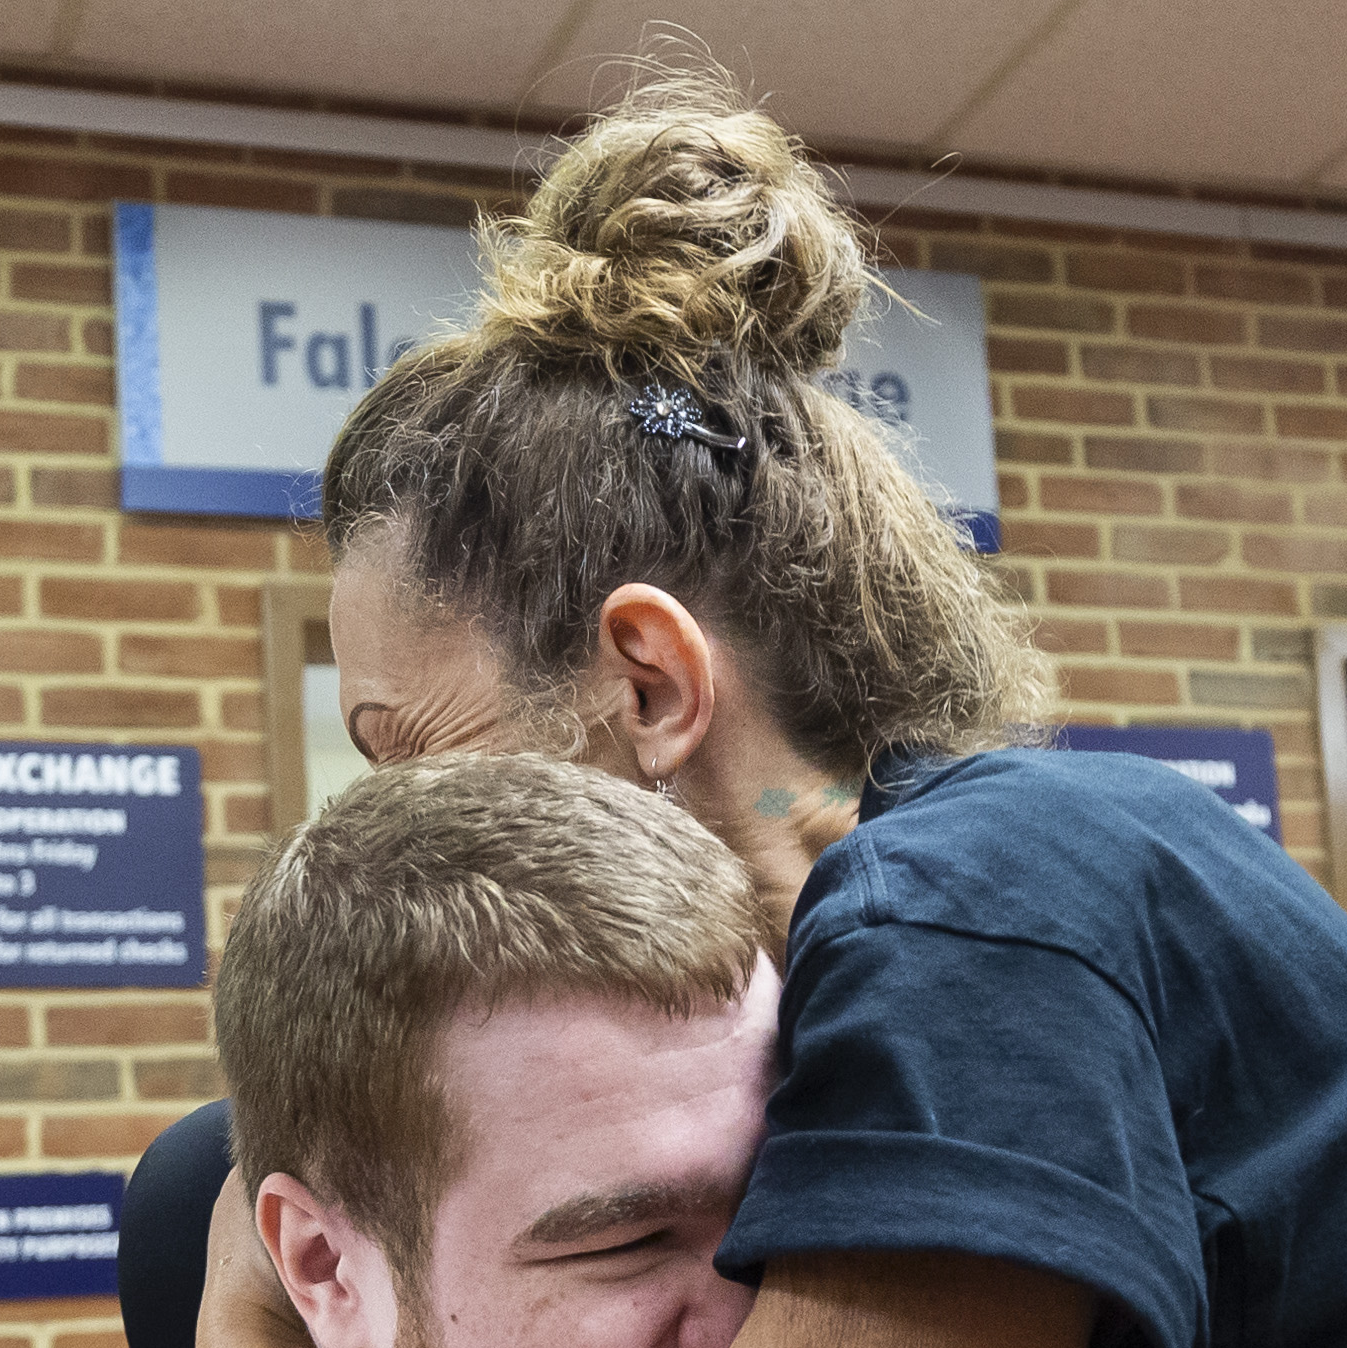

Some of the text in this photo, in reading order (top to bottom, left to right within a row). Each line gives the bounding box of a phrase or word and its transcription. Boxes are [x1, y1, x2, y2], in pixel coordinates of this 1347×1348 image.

[31, 837, 99, 872] Friday
[19, 868, 38, 898] 3
[30, 905, 59, 935] all
[60, 907, 186, 935] transactions
[25, 937, 117, 966] returned
[118, 936, 189, 967] checks
[12, 1203, 113, 1234] PREMISES
